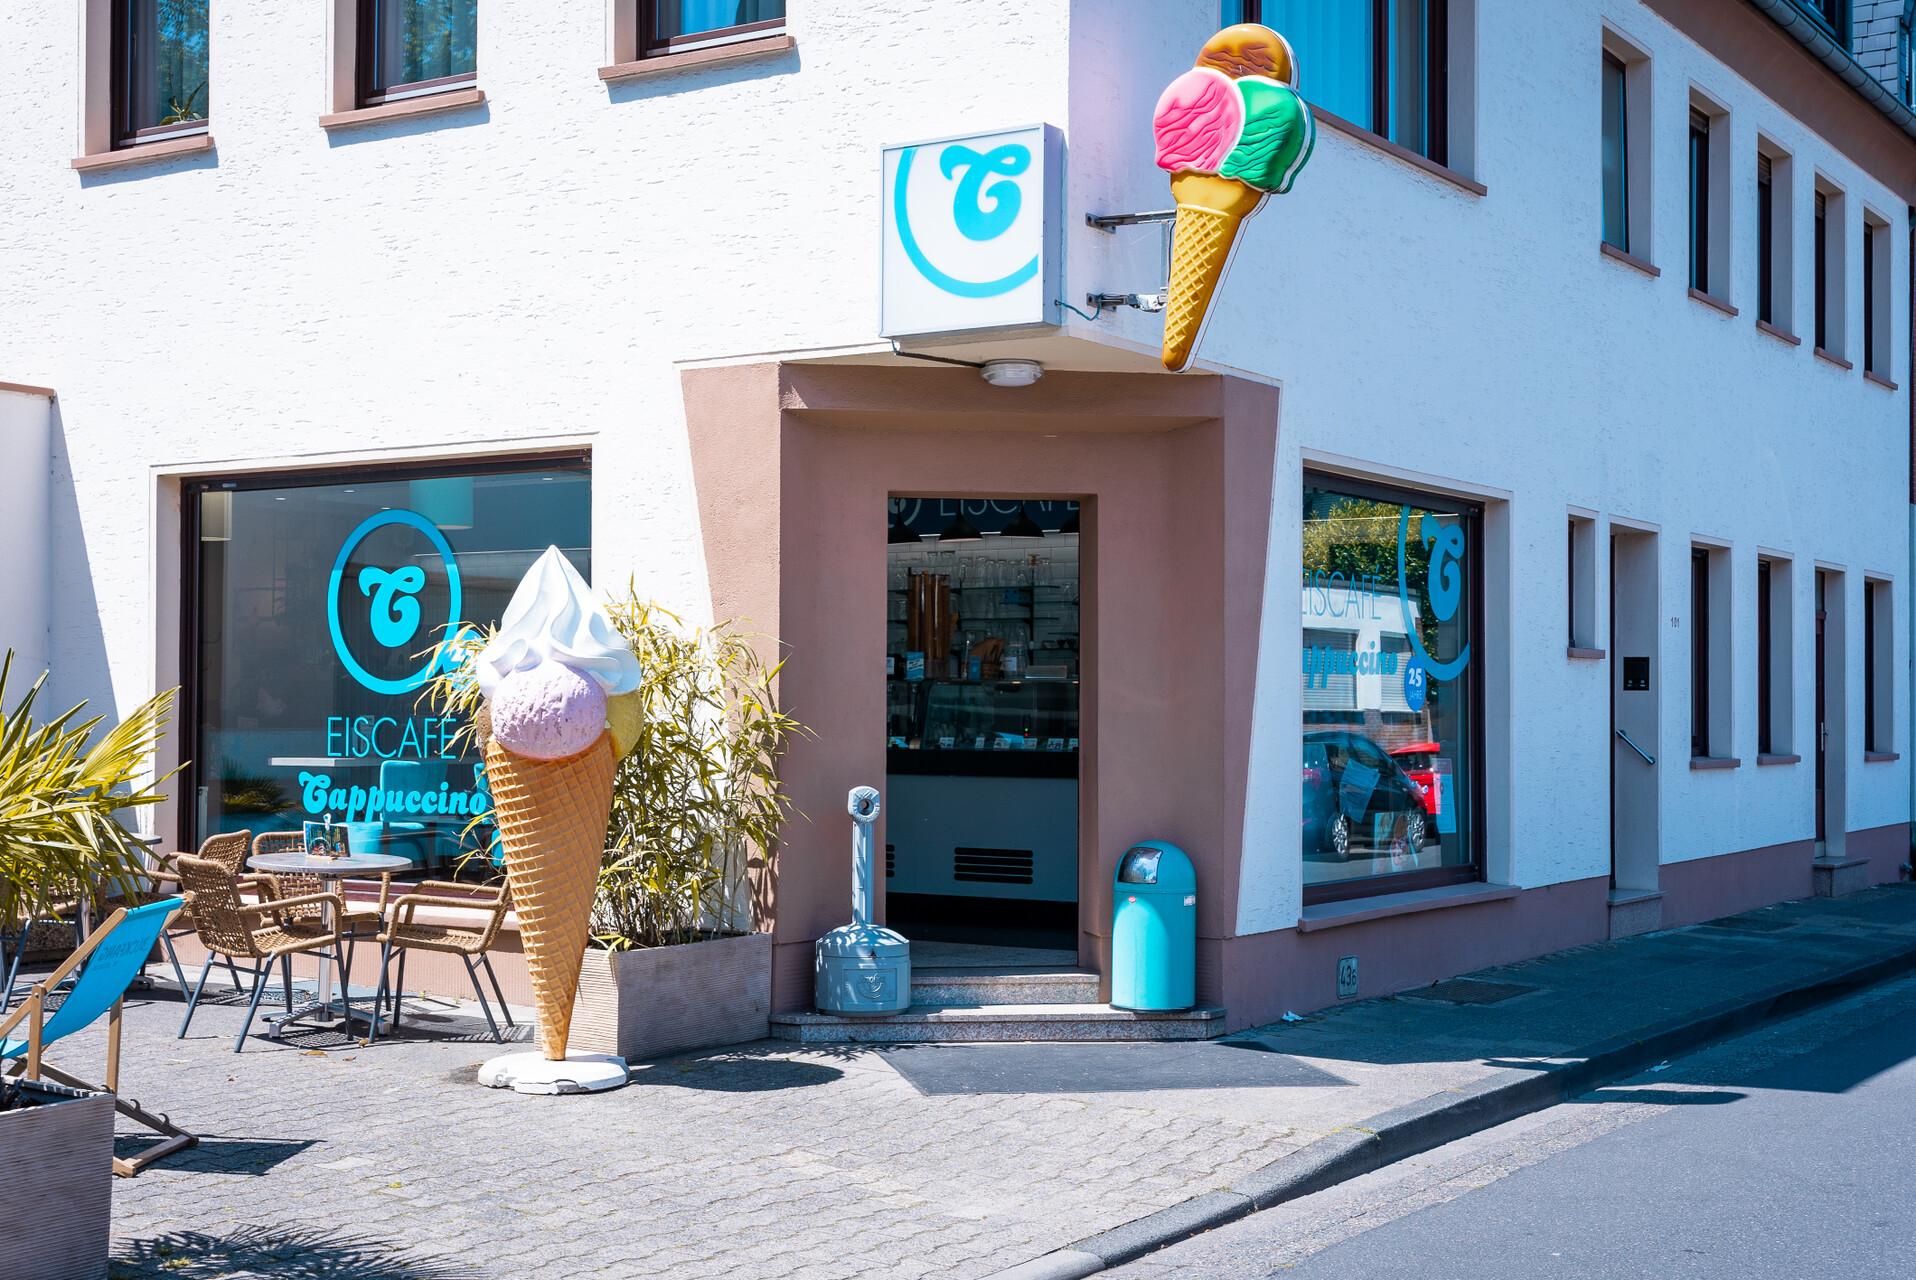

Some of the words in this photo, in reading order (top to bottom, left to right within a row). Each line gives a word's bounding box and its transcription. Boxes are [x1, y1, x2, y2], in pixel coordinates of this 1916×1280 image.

[1303, 640, 1398, 689] appuccino
[1408, 667, 1422, 687] 25
[299, 770, 487, 822] Cappuccino
